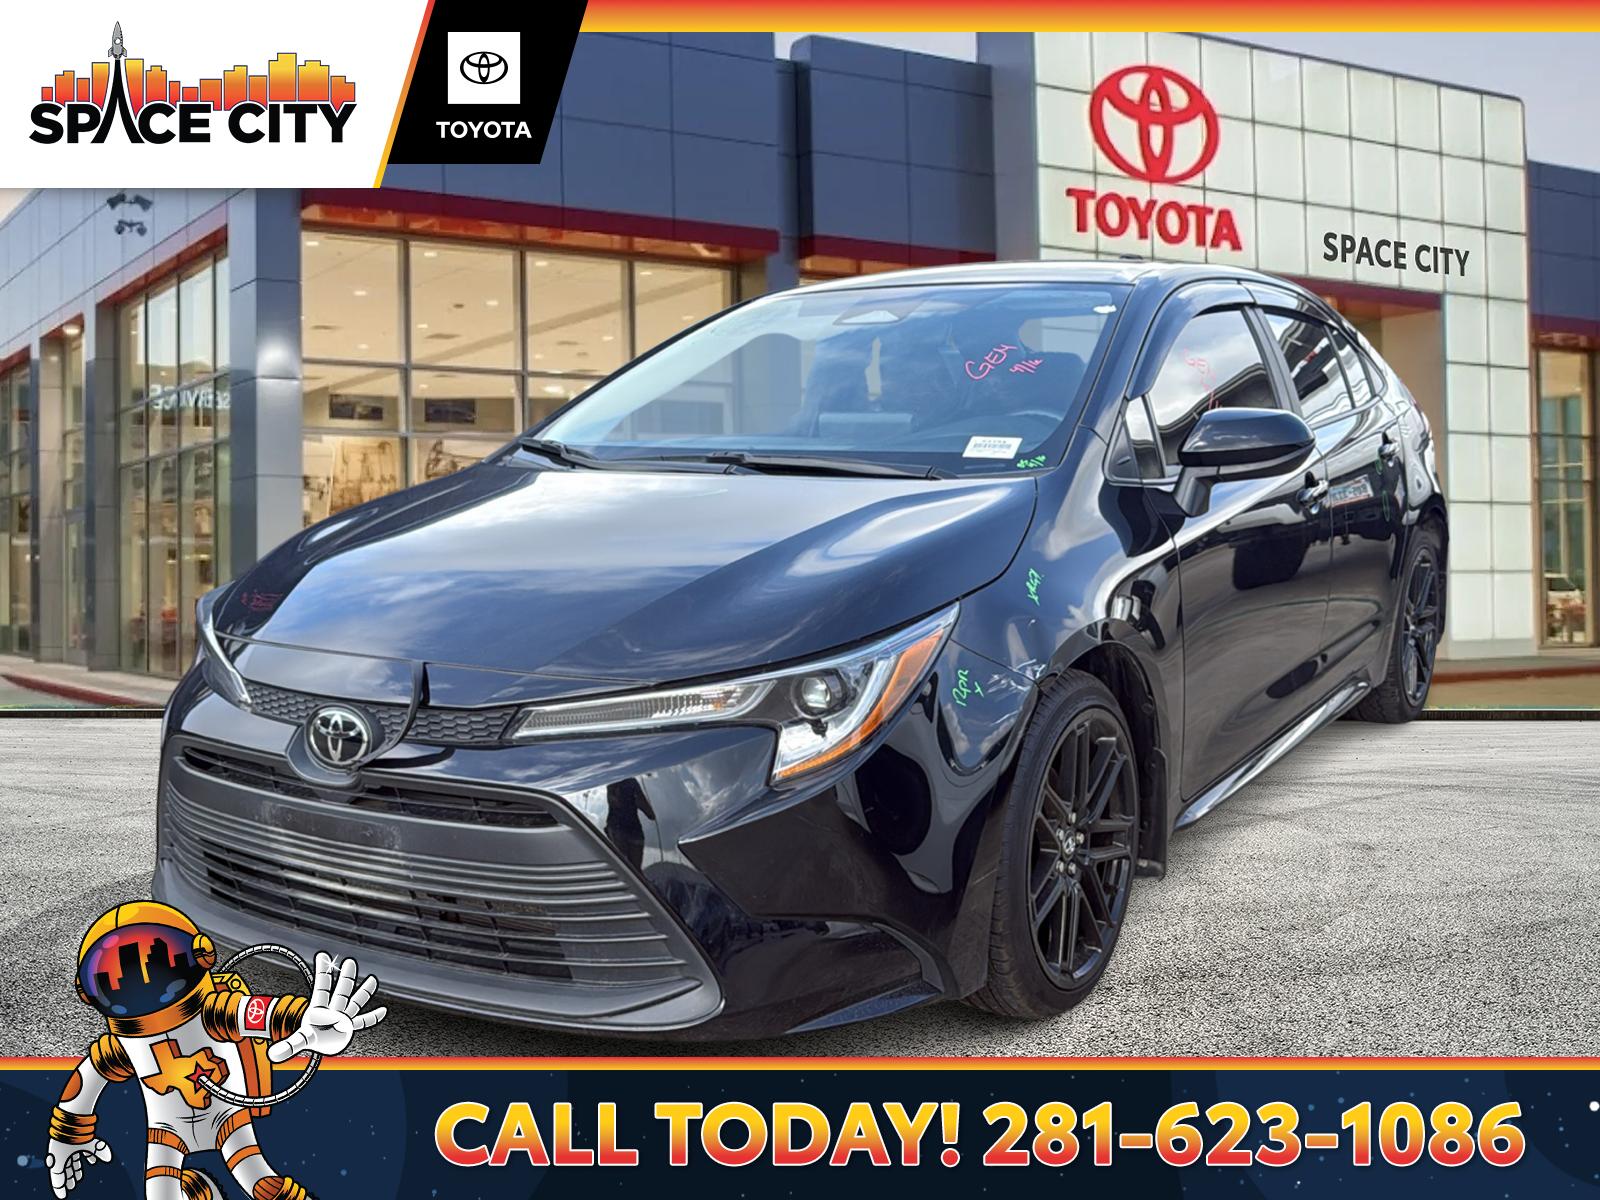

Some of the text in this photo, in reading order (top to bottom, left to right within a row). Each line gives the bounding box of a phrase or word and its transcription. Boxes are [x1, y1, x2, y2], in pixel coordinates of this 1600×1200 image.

[1066, 187, 1243, 251] TOYOTA
[1323, 231, 1470, 277] SPACE CITY
